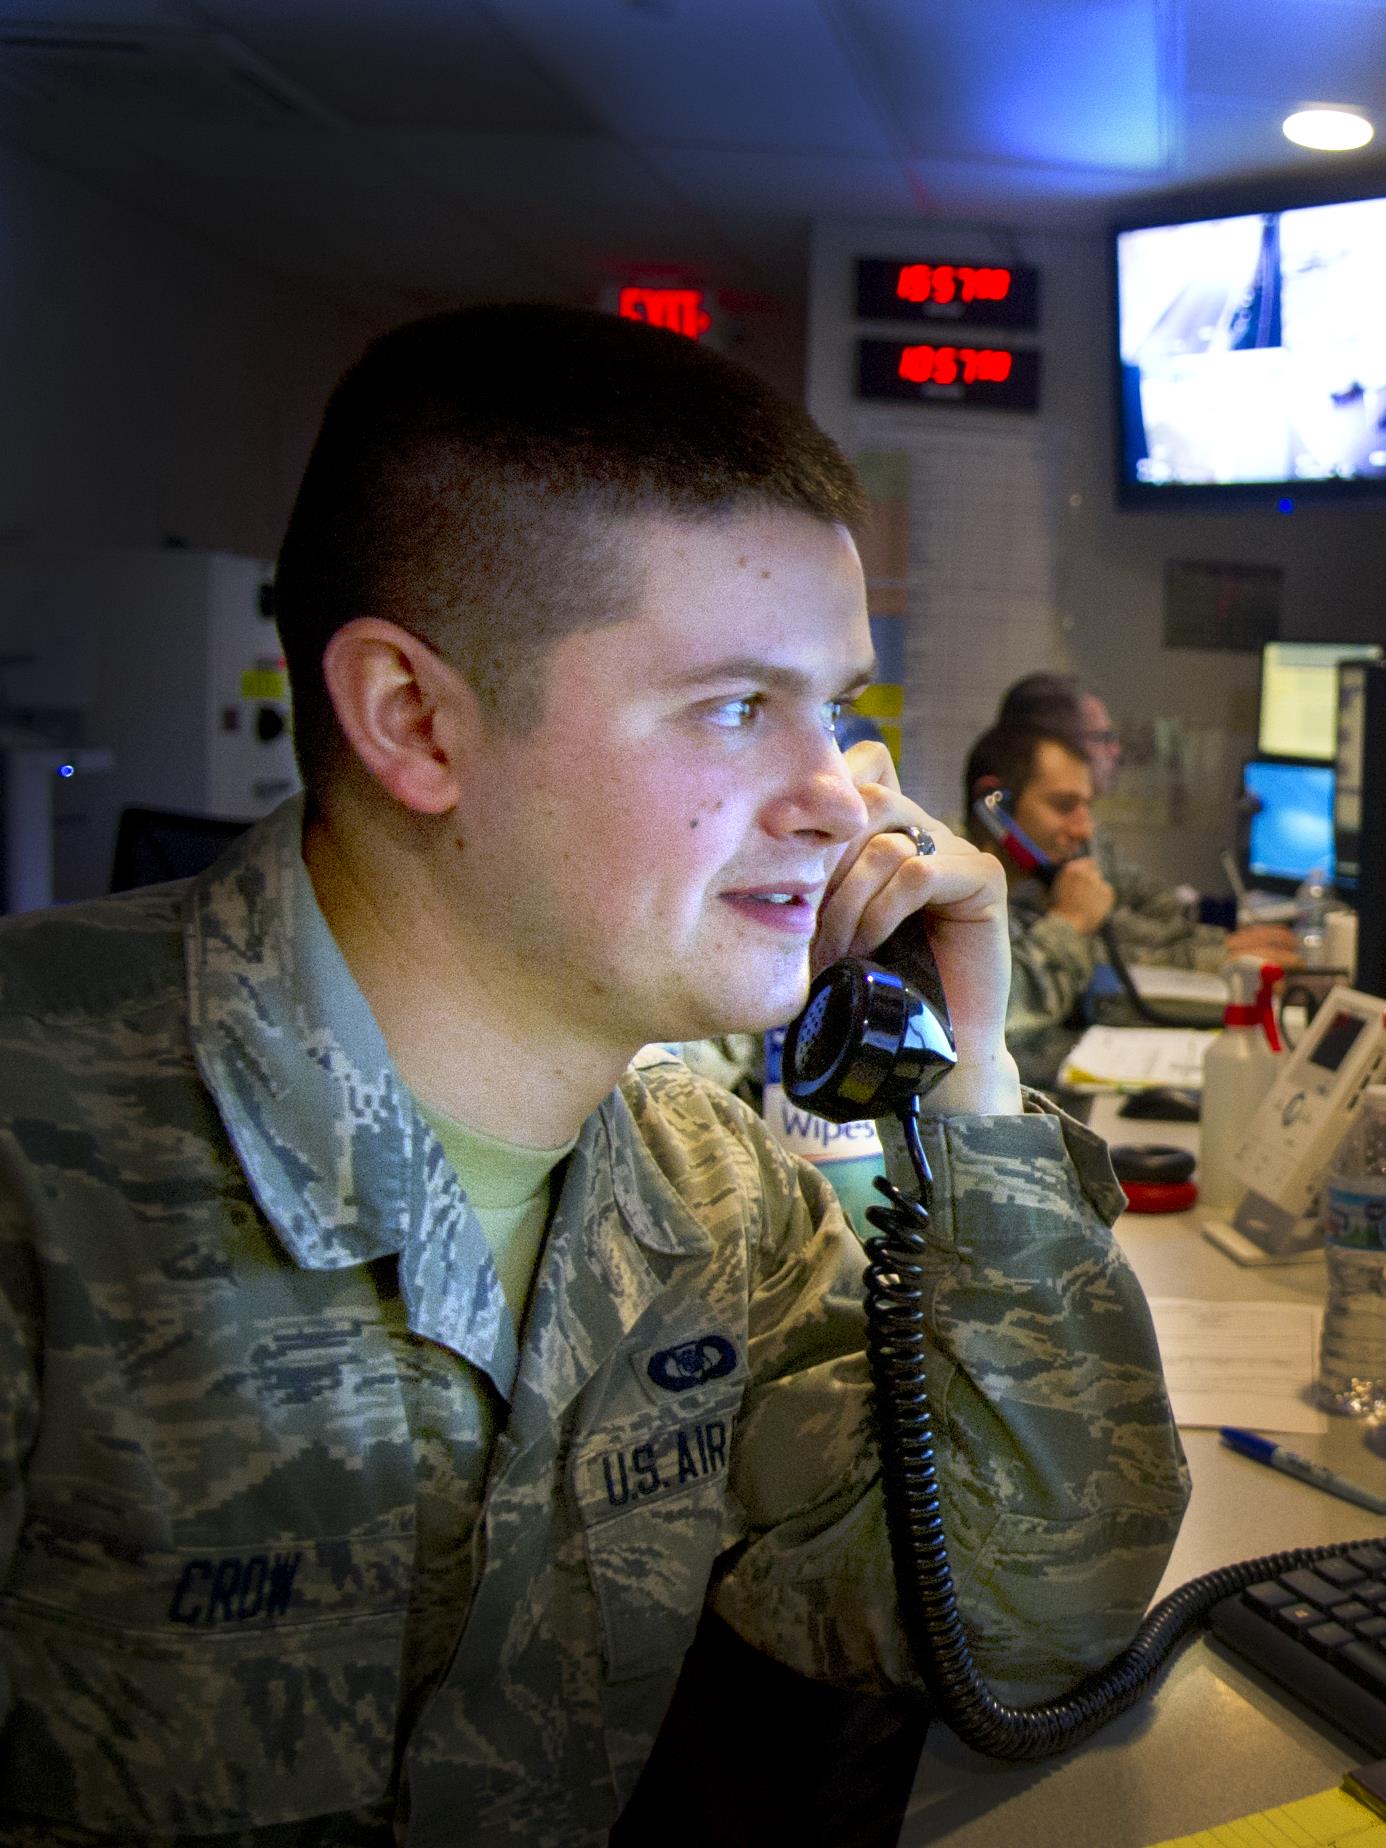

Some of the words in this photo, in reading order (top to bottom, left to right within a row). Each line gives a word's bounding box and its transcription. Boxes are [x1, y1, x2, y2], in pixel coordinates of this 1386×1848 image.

[603, 1443, 670, 1506] U.S.
[677, 1419, 726, 1484] AIR
[168, 1551, 304, 1624] CROW
